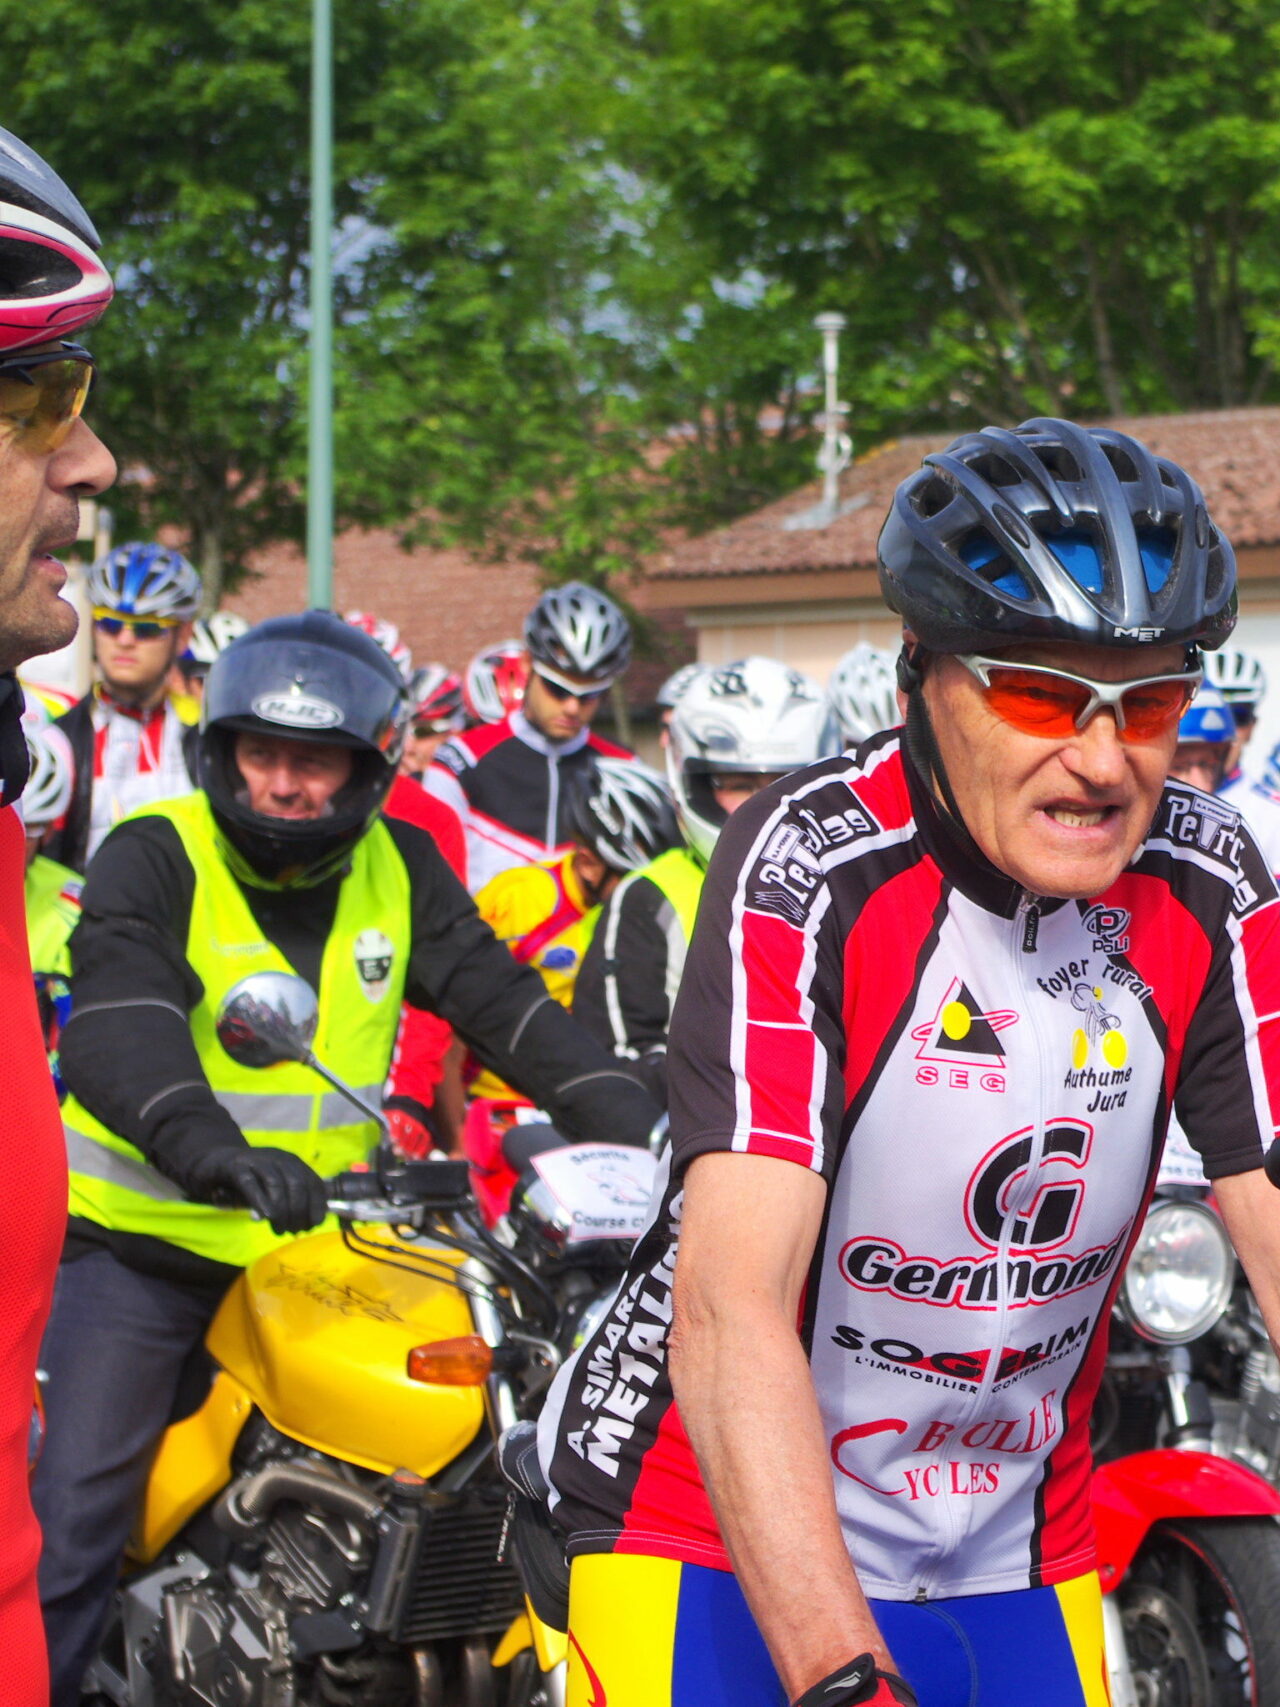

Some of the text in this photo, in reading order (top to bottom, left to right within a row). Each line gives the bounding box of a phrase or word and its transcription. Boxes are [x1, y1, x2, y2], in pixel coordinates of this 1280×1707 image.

[1113, 626, 1166, 642] MET
[1102, 962, 1154, 1003] rural
[915, 1066, 1006, 1094] SEG
[1064, 1061, 1133, 1090] Authume
[1086, 1090, 1128, 1114] Jura
[963, 1117, 1094, 1254] G
[572, 1211, 627, 1230] Course
[840, 1219, 1132, 1309] Germond
[831, 1315, 1090, 1383] SOGERIM
[854, 1339, 1083, 1395] L'IMMOBILIER CONTEMPORAIN
